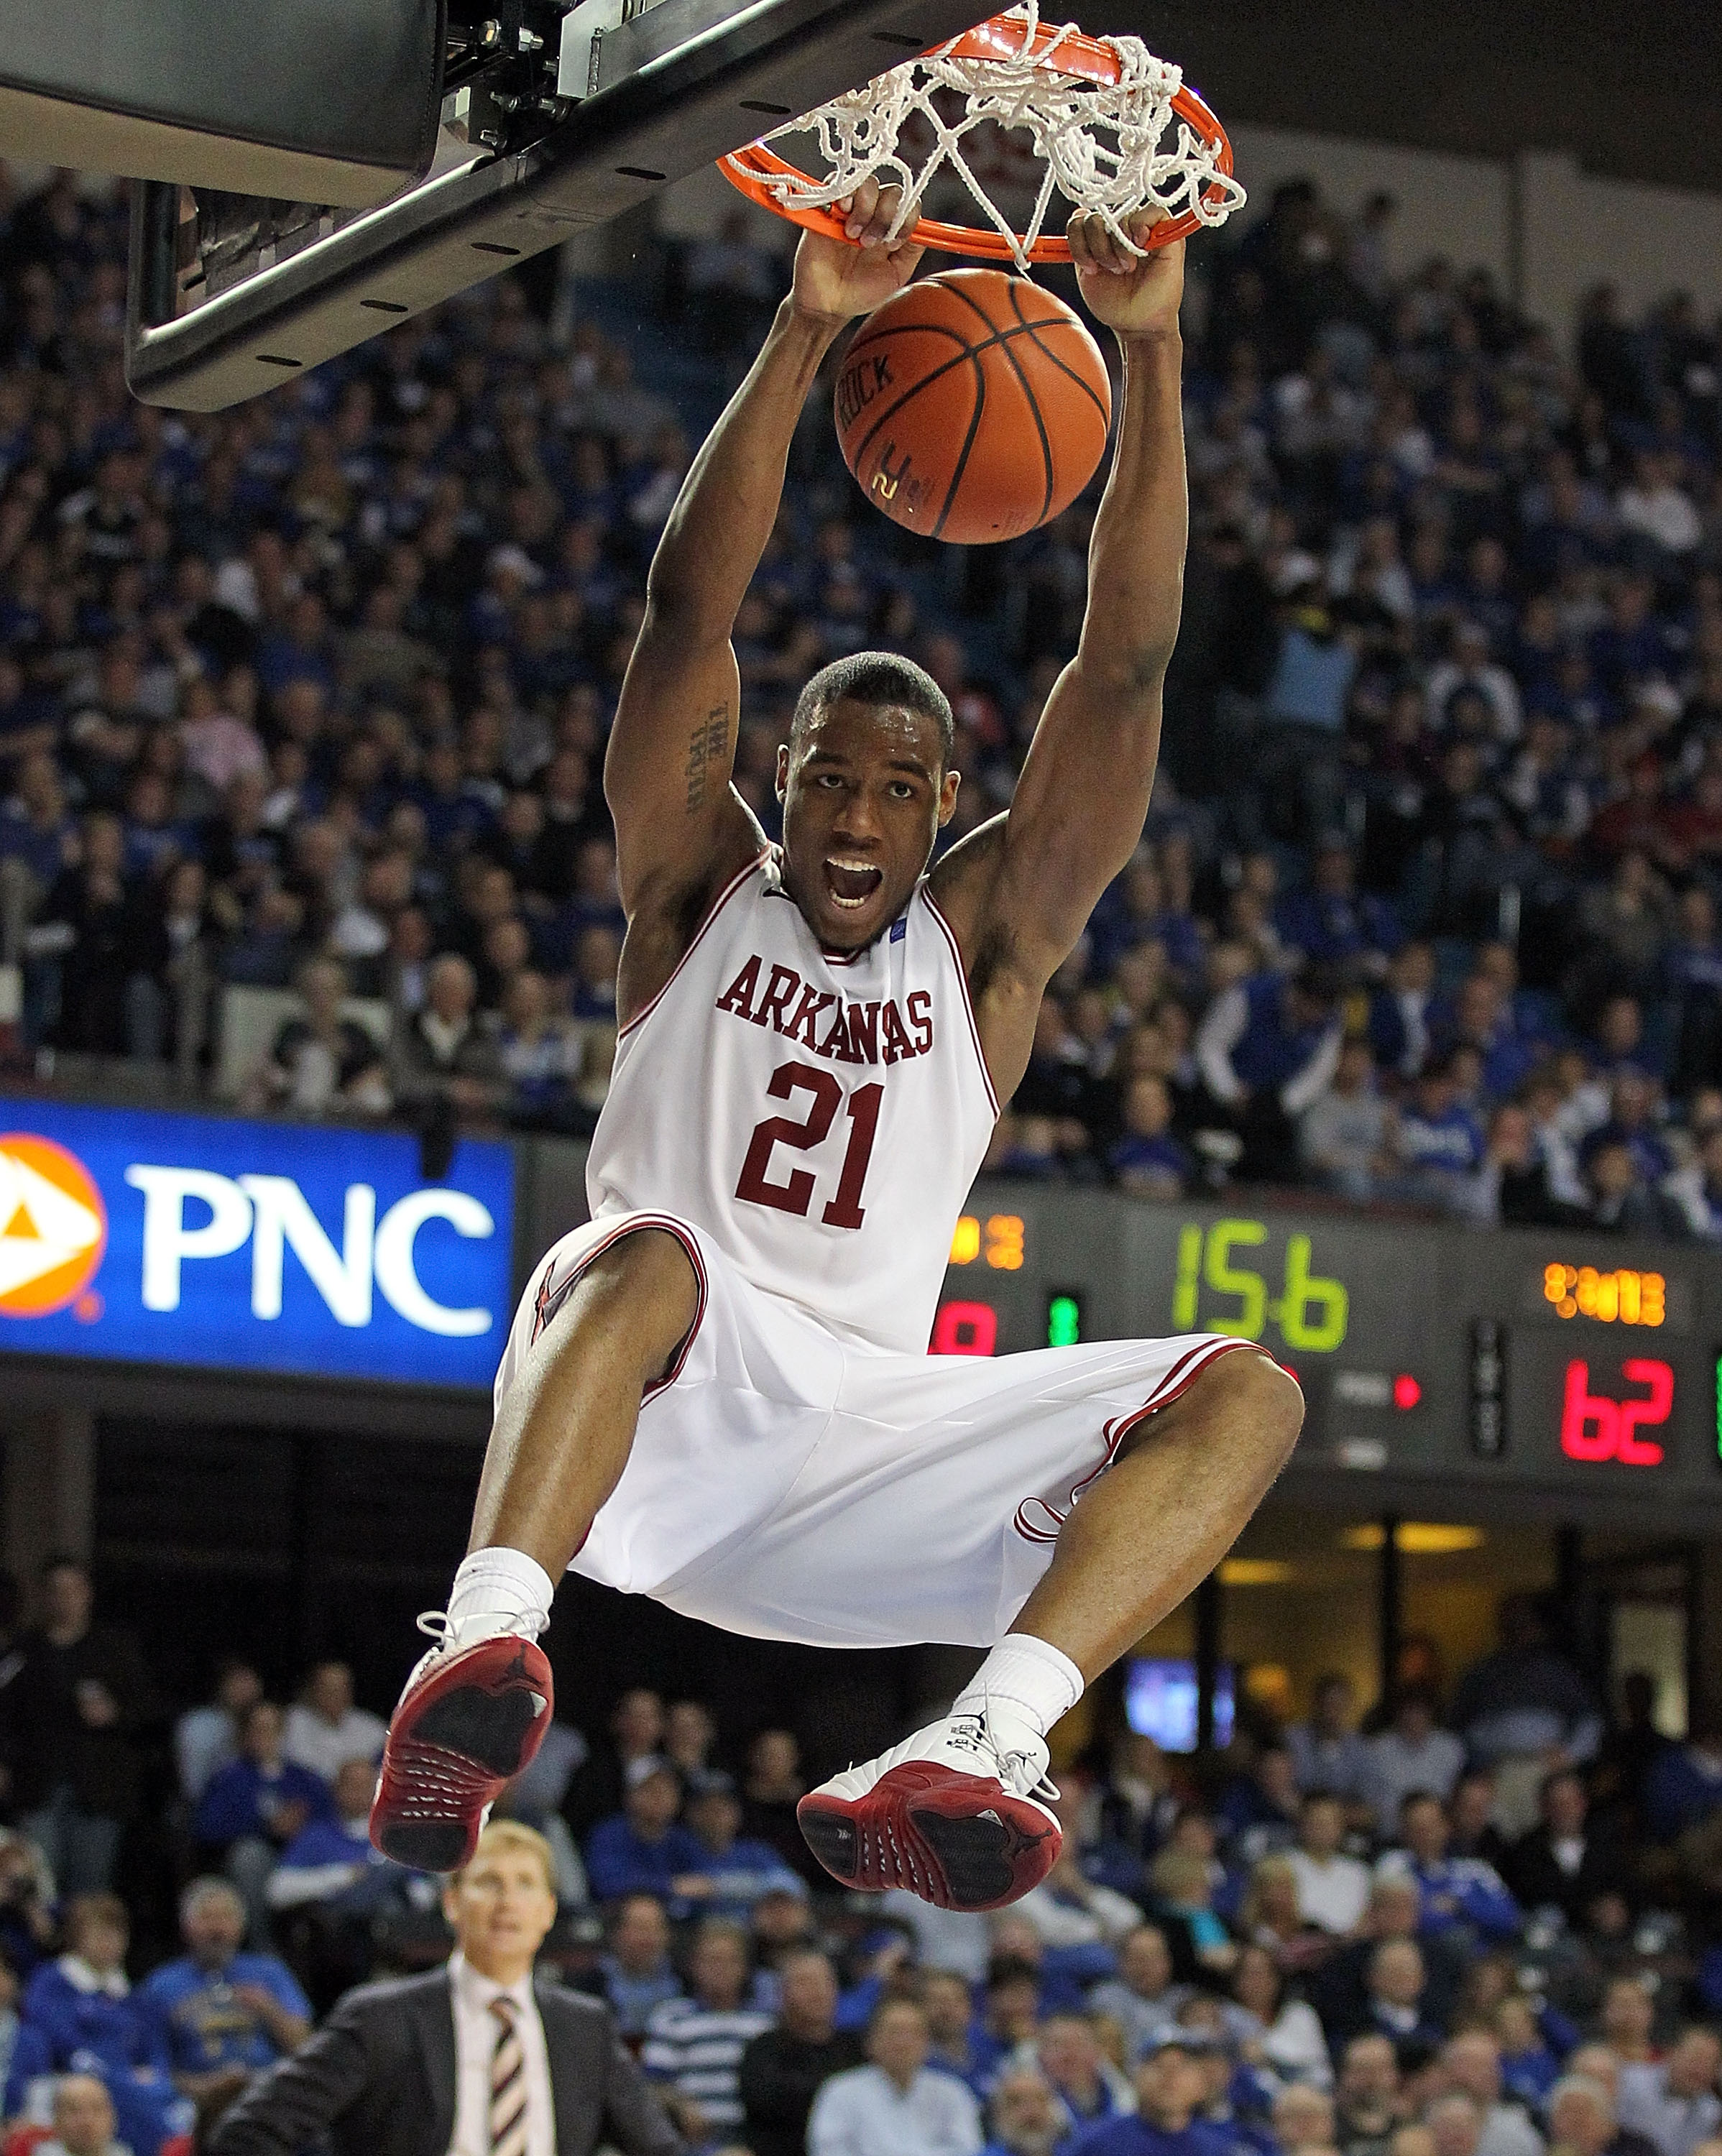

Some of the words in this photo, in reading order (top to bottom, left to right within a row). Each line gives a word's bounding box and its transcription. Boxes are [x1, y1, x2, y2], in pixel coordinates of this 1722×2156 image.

[735, 1060, 886, 1230] 21
[124, 1164, 494, 1337] PNC
[1561, 1357, 1674, 1465] 62
